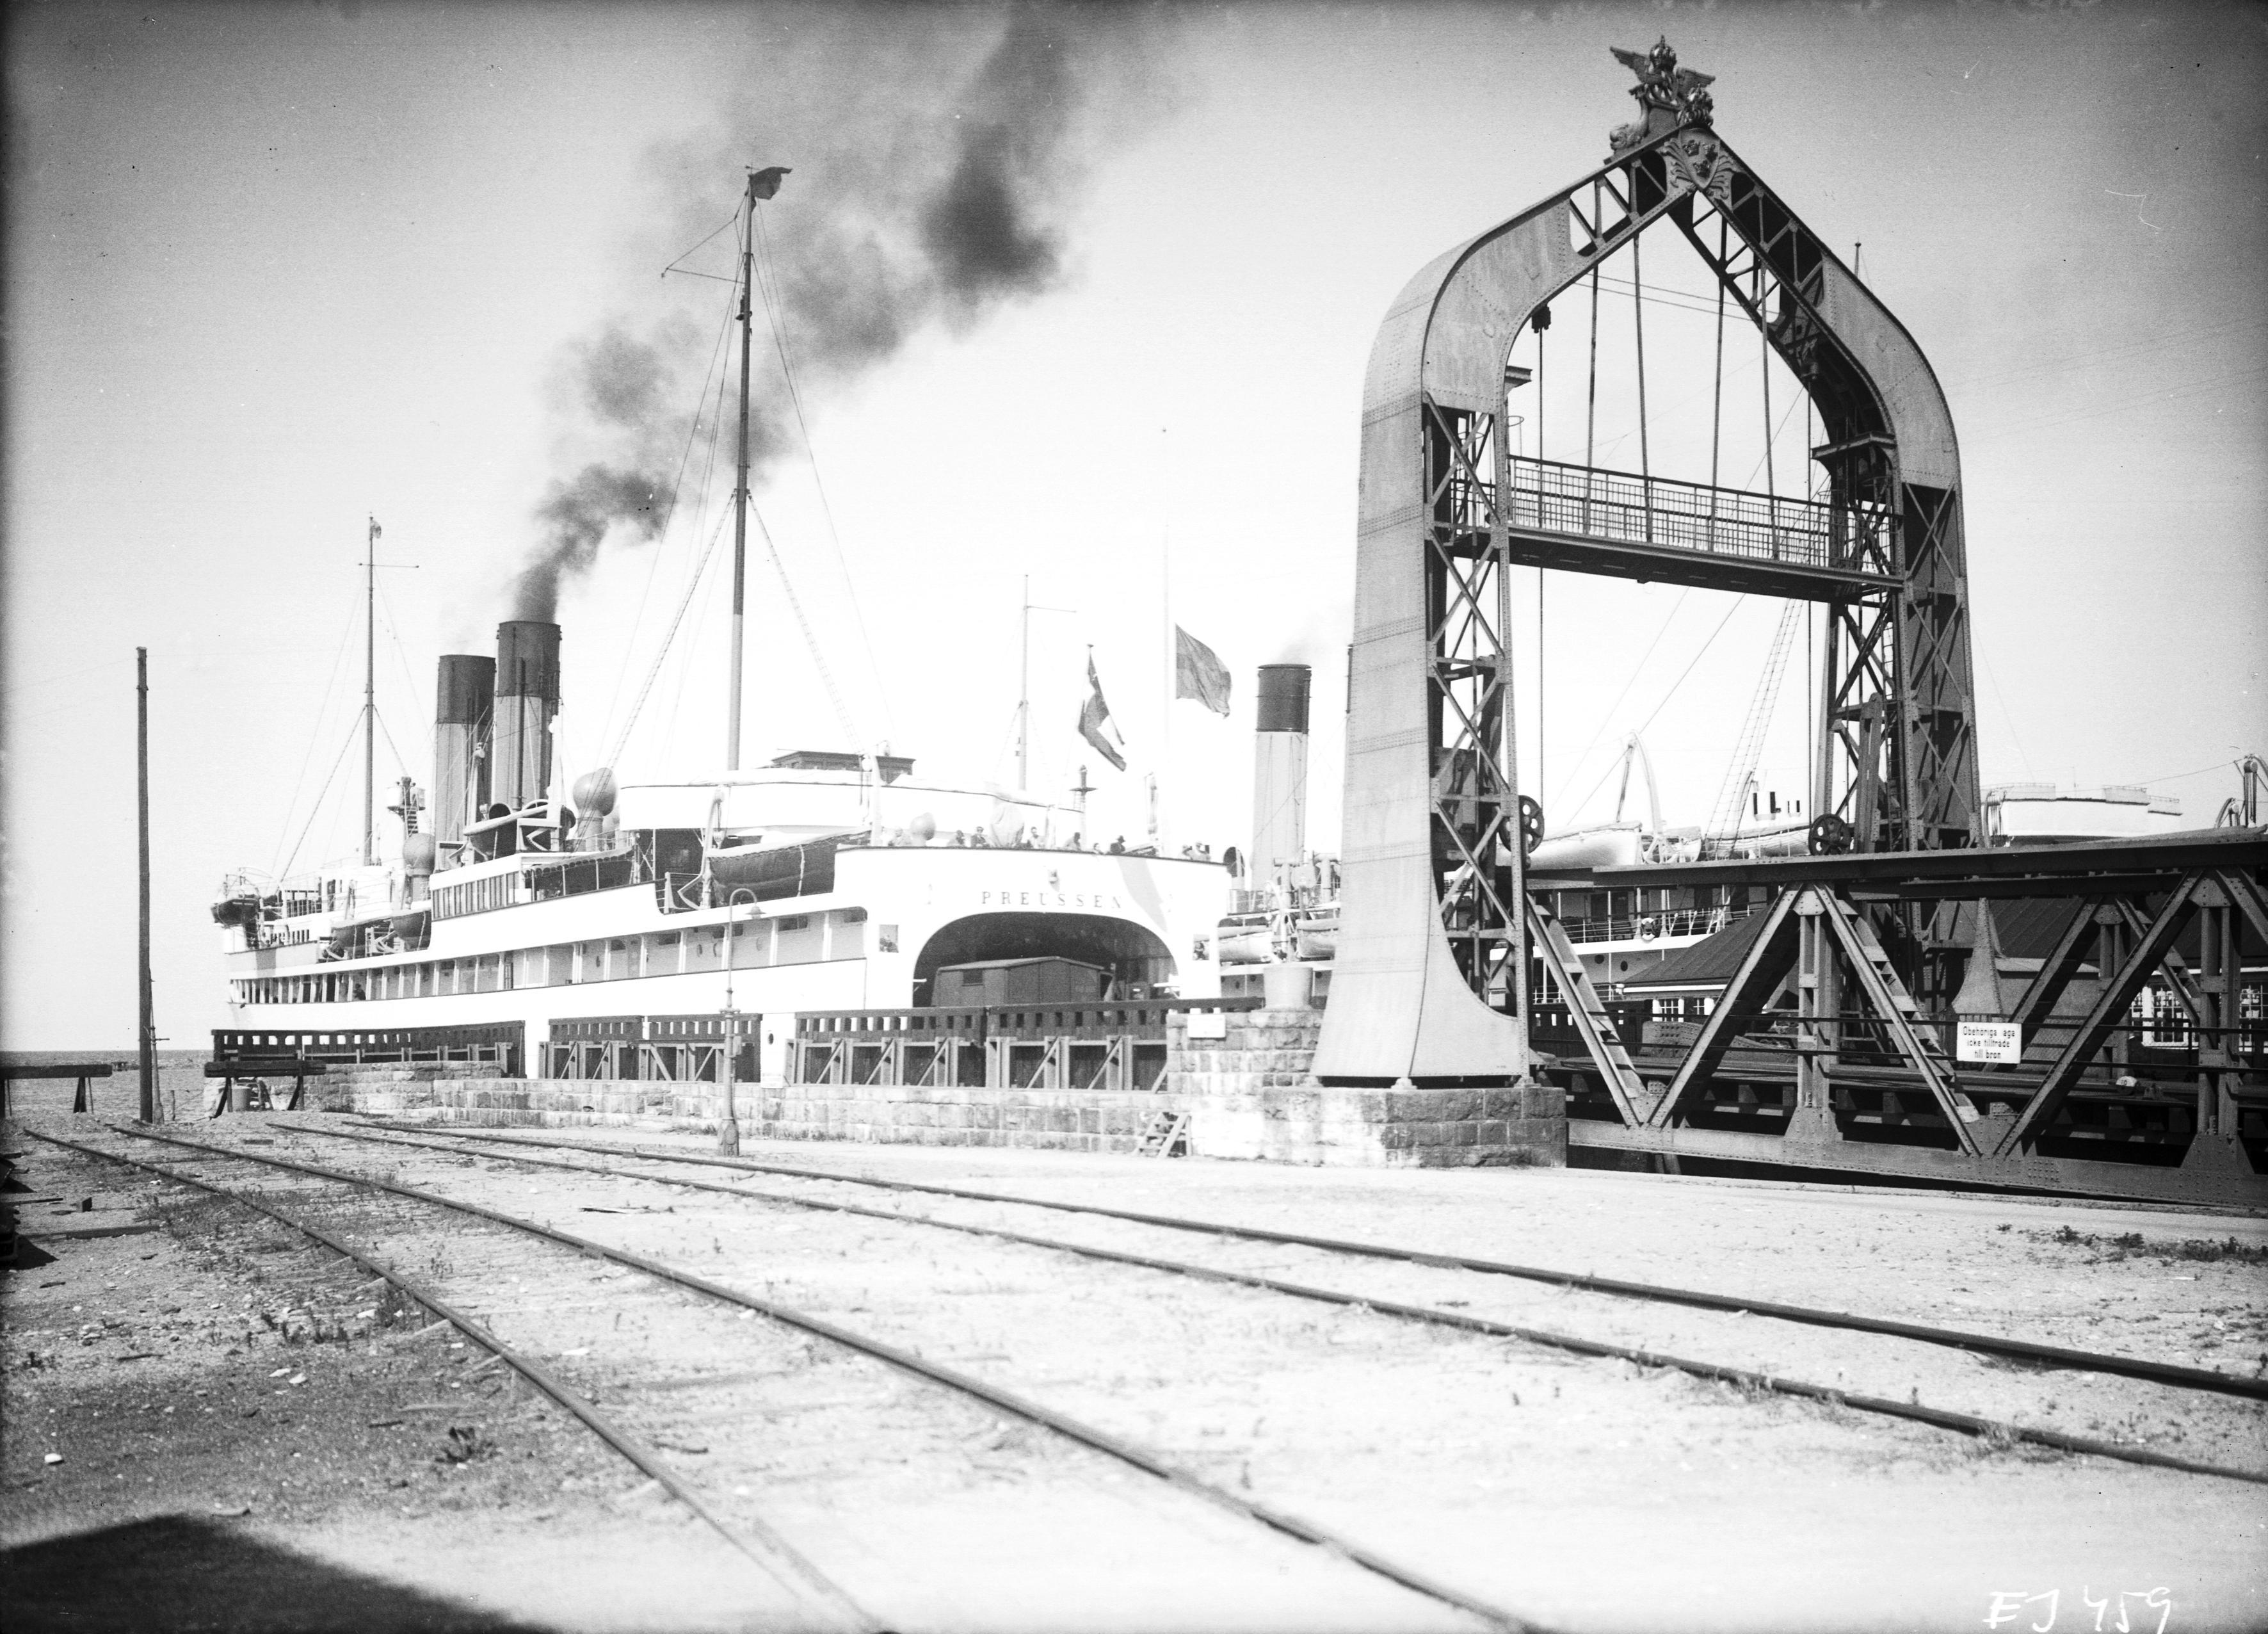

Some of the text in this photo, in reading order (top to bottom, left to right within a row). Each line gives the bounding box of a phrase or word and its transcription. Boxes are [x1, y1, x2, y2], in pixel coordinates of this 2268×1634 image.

[981, 891, 1122, 909] PREUSSEN
[1966, 1038, 1981, 1047] icke
[1974, 1049, 1983, 1058] till
